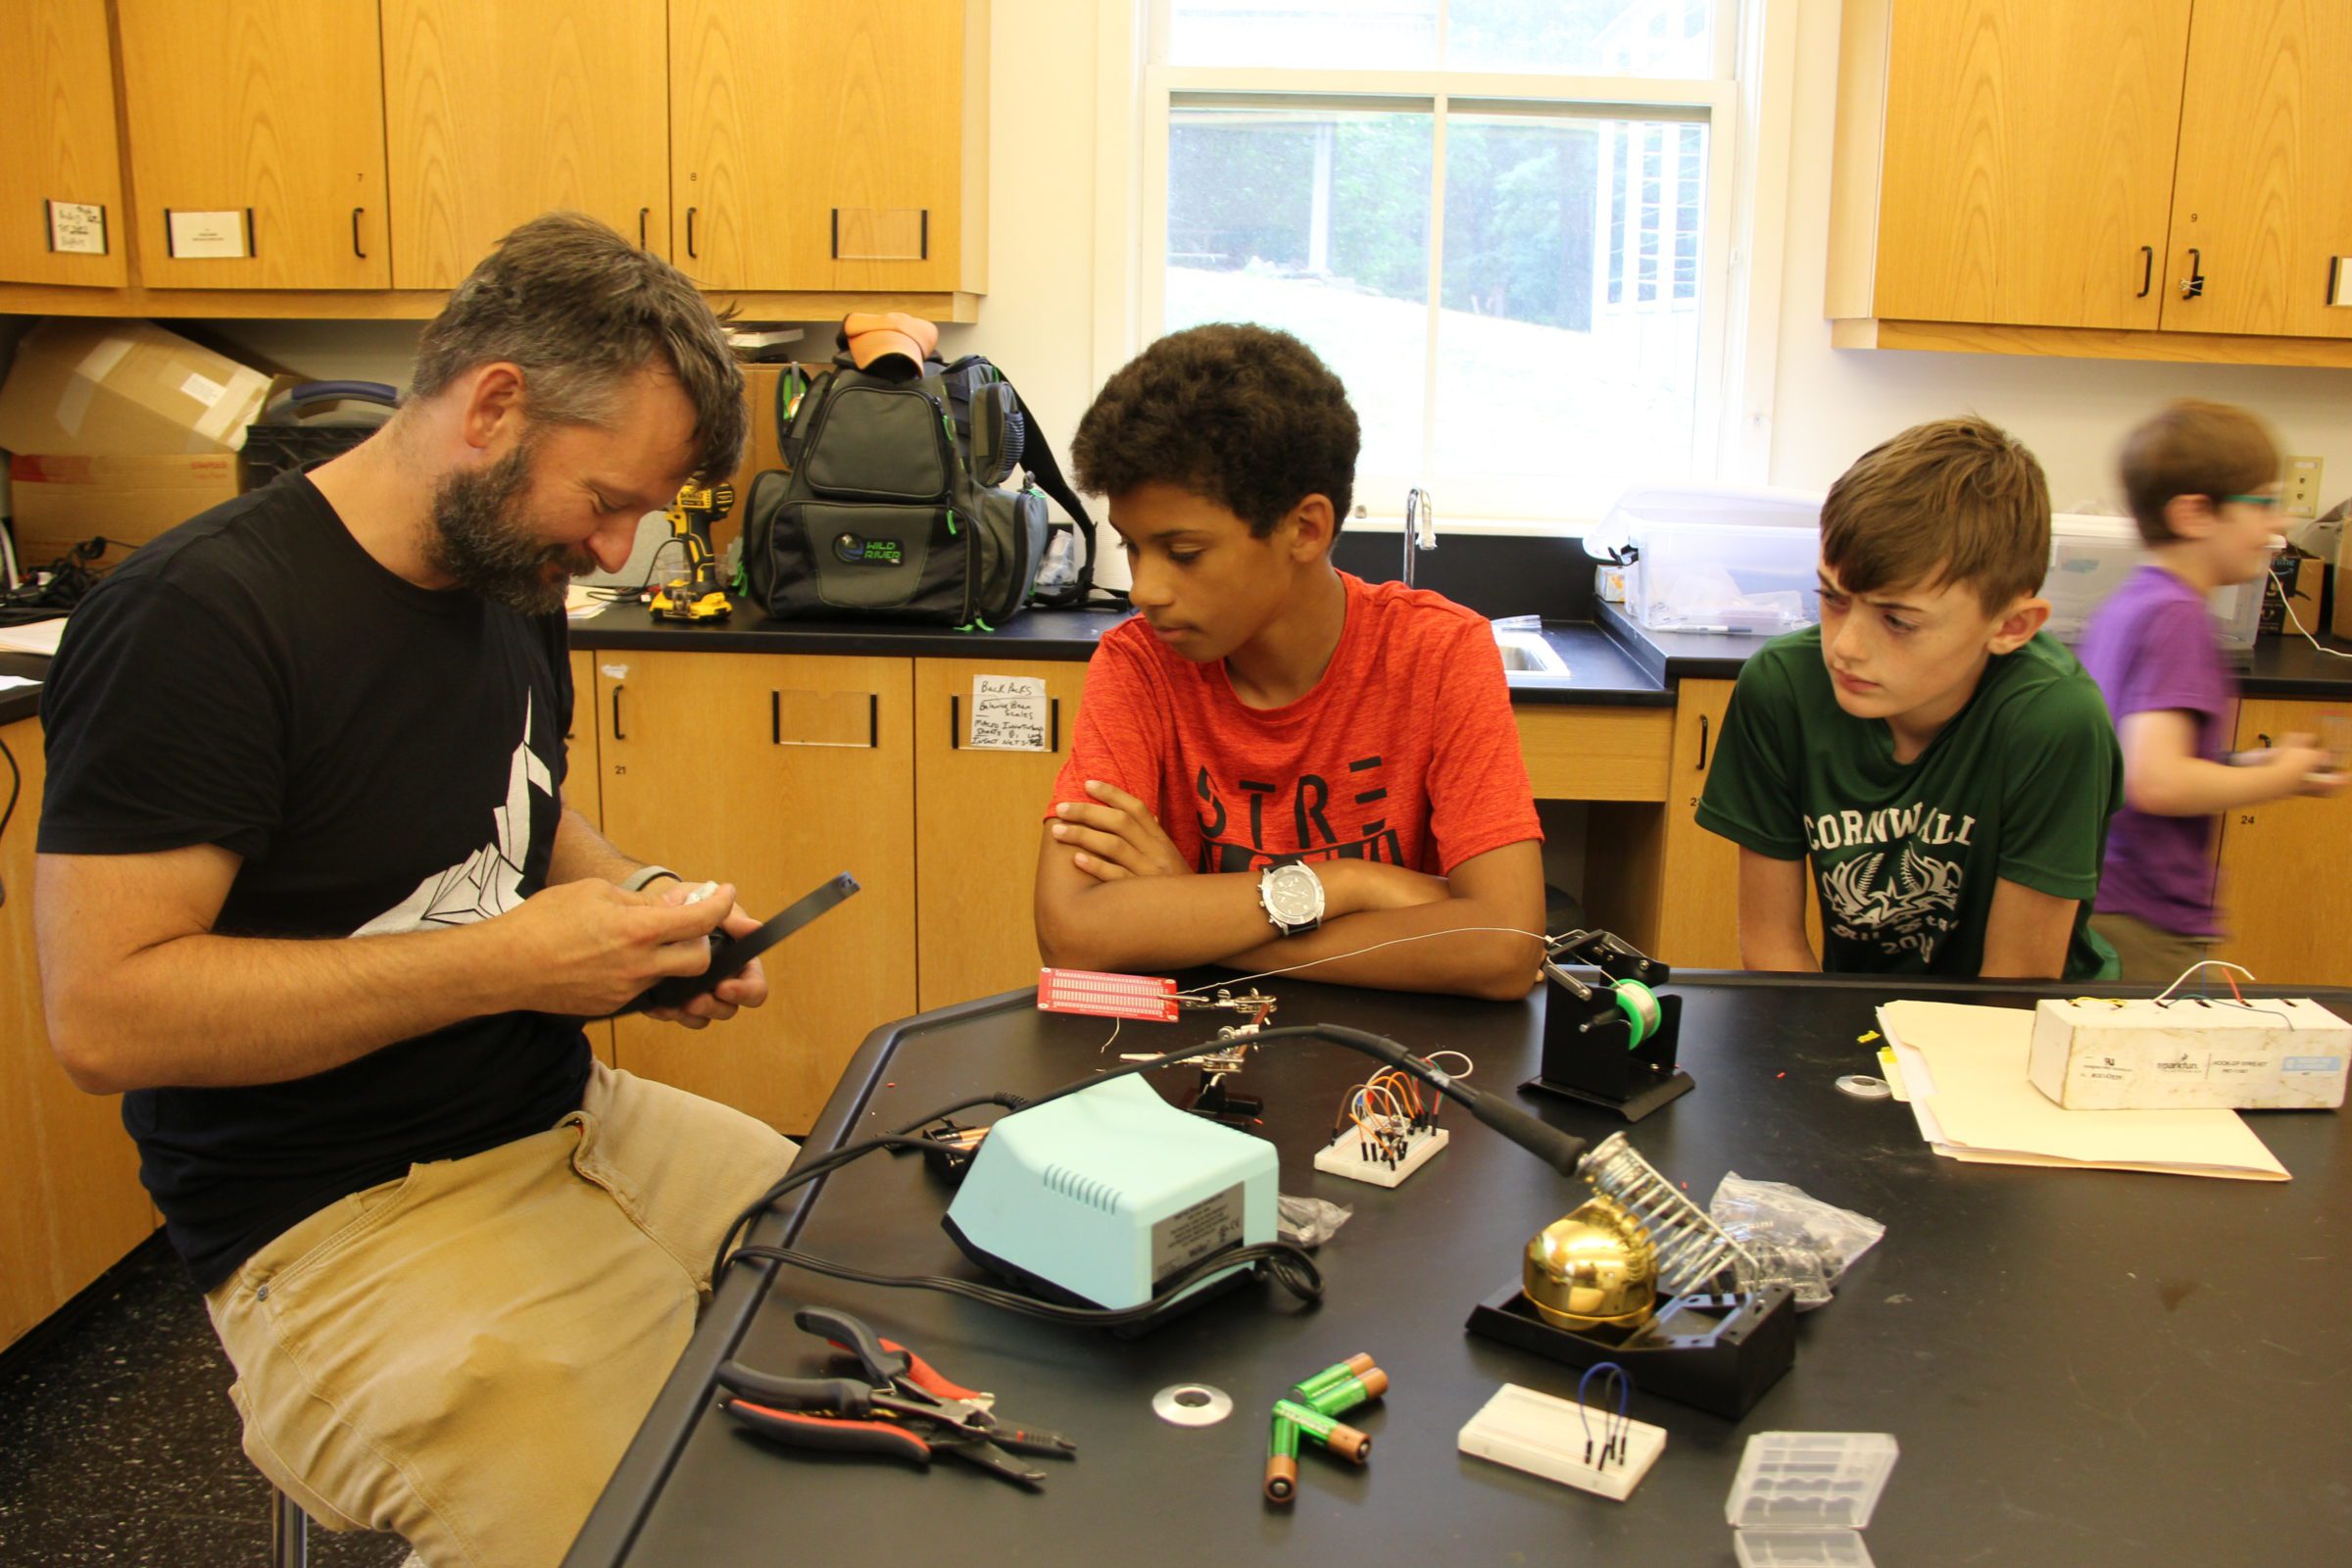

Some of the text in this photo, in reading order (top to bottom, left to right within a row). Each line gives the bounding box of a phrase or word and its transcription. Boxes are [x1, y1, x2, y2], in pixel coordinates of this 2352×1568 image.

[357, 172, 364, 182] 7
[690, 172, 697, 182] 8
[2190, 213, 2198, 222] 9
[866, 541, 896, 550] WILD
[864, 550, 901, 559] RIVER
[614, 764, 626, 775] 21
[2240, 814, 2255, 825] 24
[1803, 802, 1976, 851] CORNWALL
